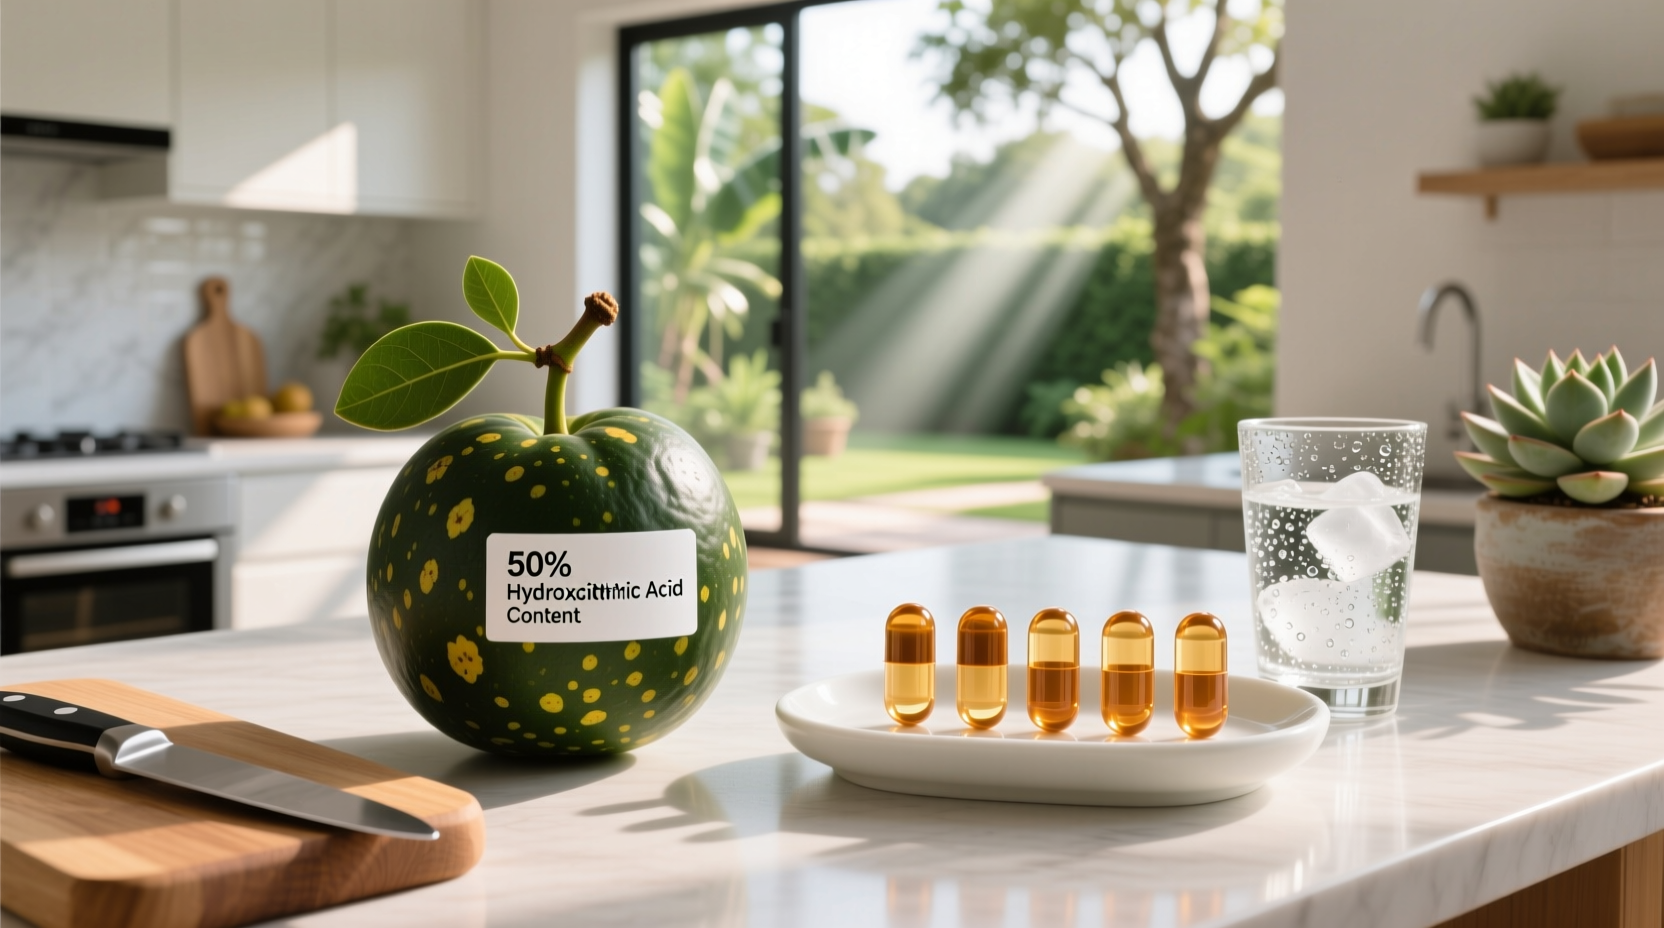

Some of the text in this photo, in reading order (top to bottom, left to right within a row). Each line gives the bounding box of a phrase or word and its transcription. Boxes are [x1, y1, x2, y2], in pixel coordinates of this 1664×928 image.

[507, 550, 572, 577] 50%
[645, 578, 683, 598] Acid
[506, 606, 582, 623] Content
